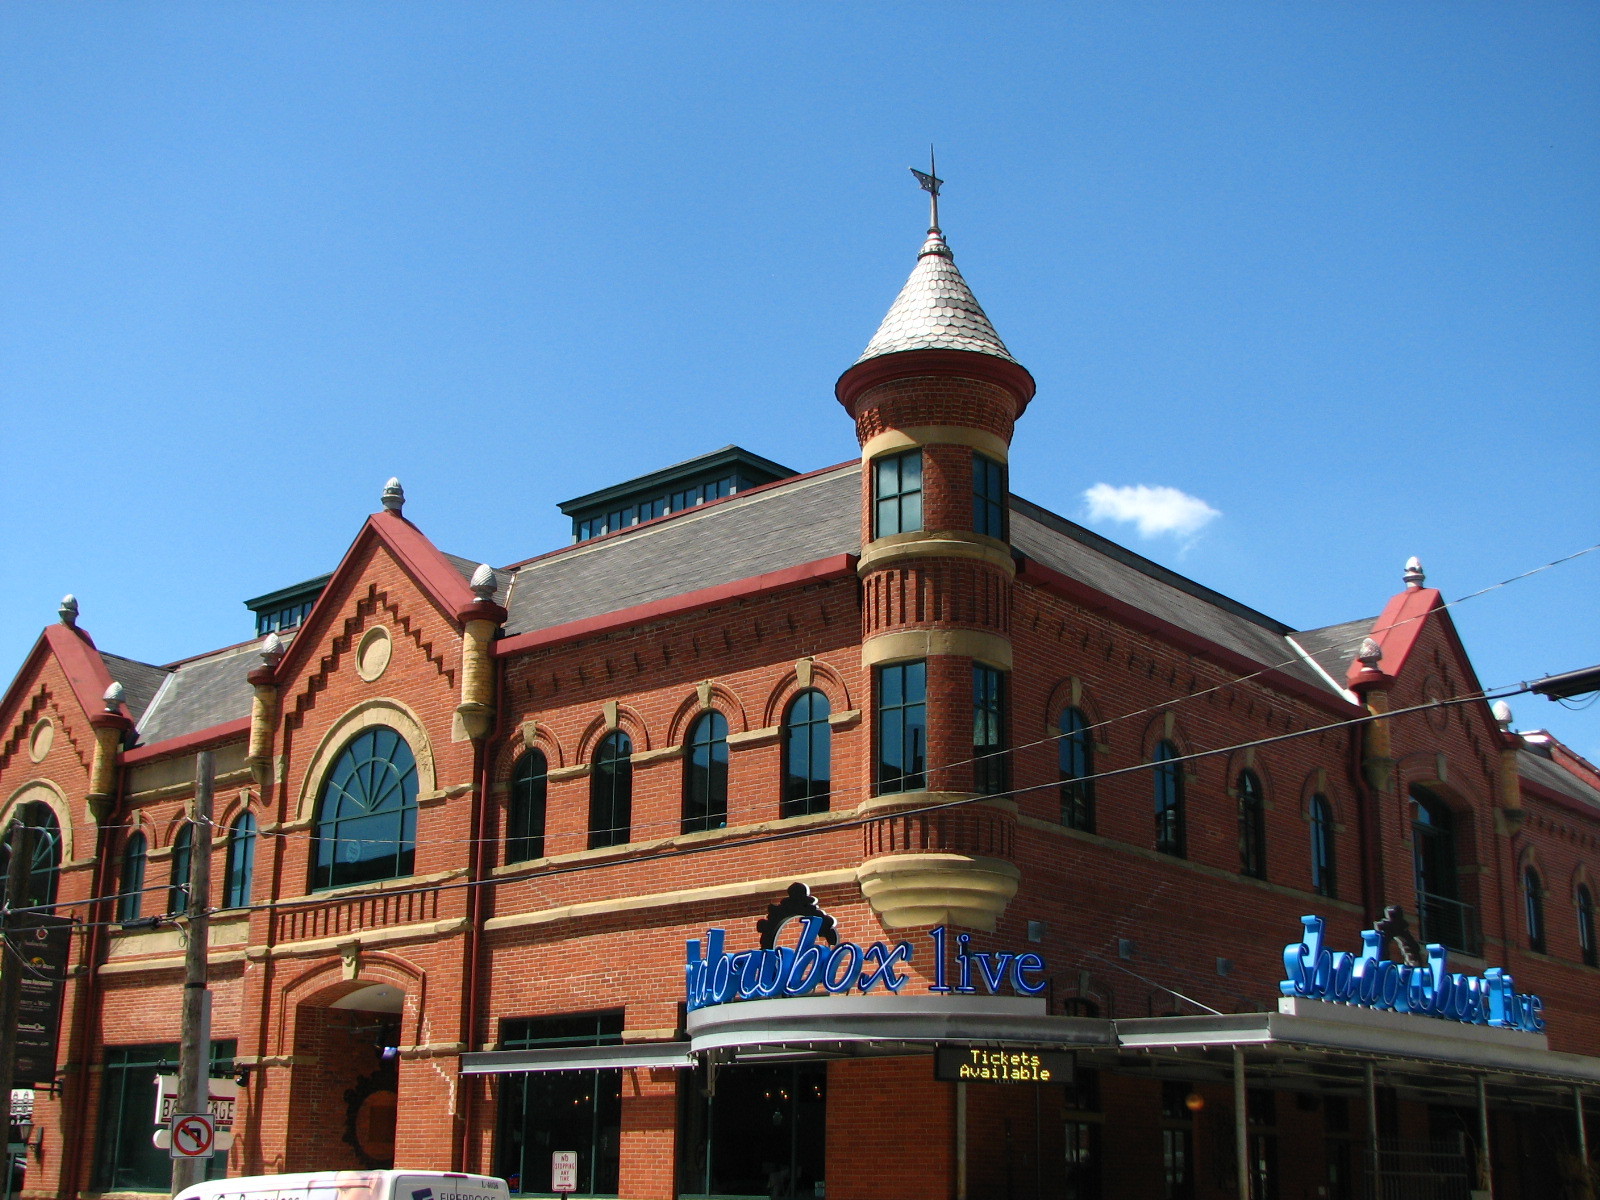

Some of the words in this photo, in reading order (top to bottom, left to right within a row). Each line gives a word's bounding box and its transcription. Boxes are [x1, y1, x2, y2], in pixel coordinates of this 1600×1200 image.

[928, 925, 1047, 995] live
[970, 1049, 1041, 1067] Tickets
[960, 1063, 1051, 1081] Available
[554, 1162, 575, 1170] STOPPING
